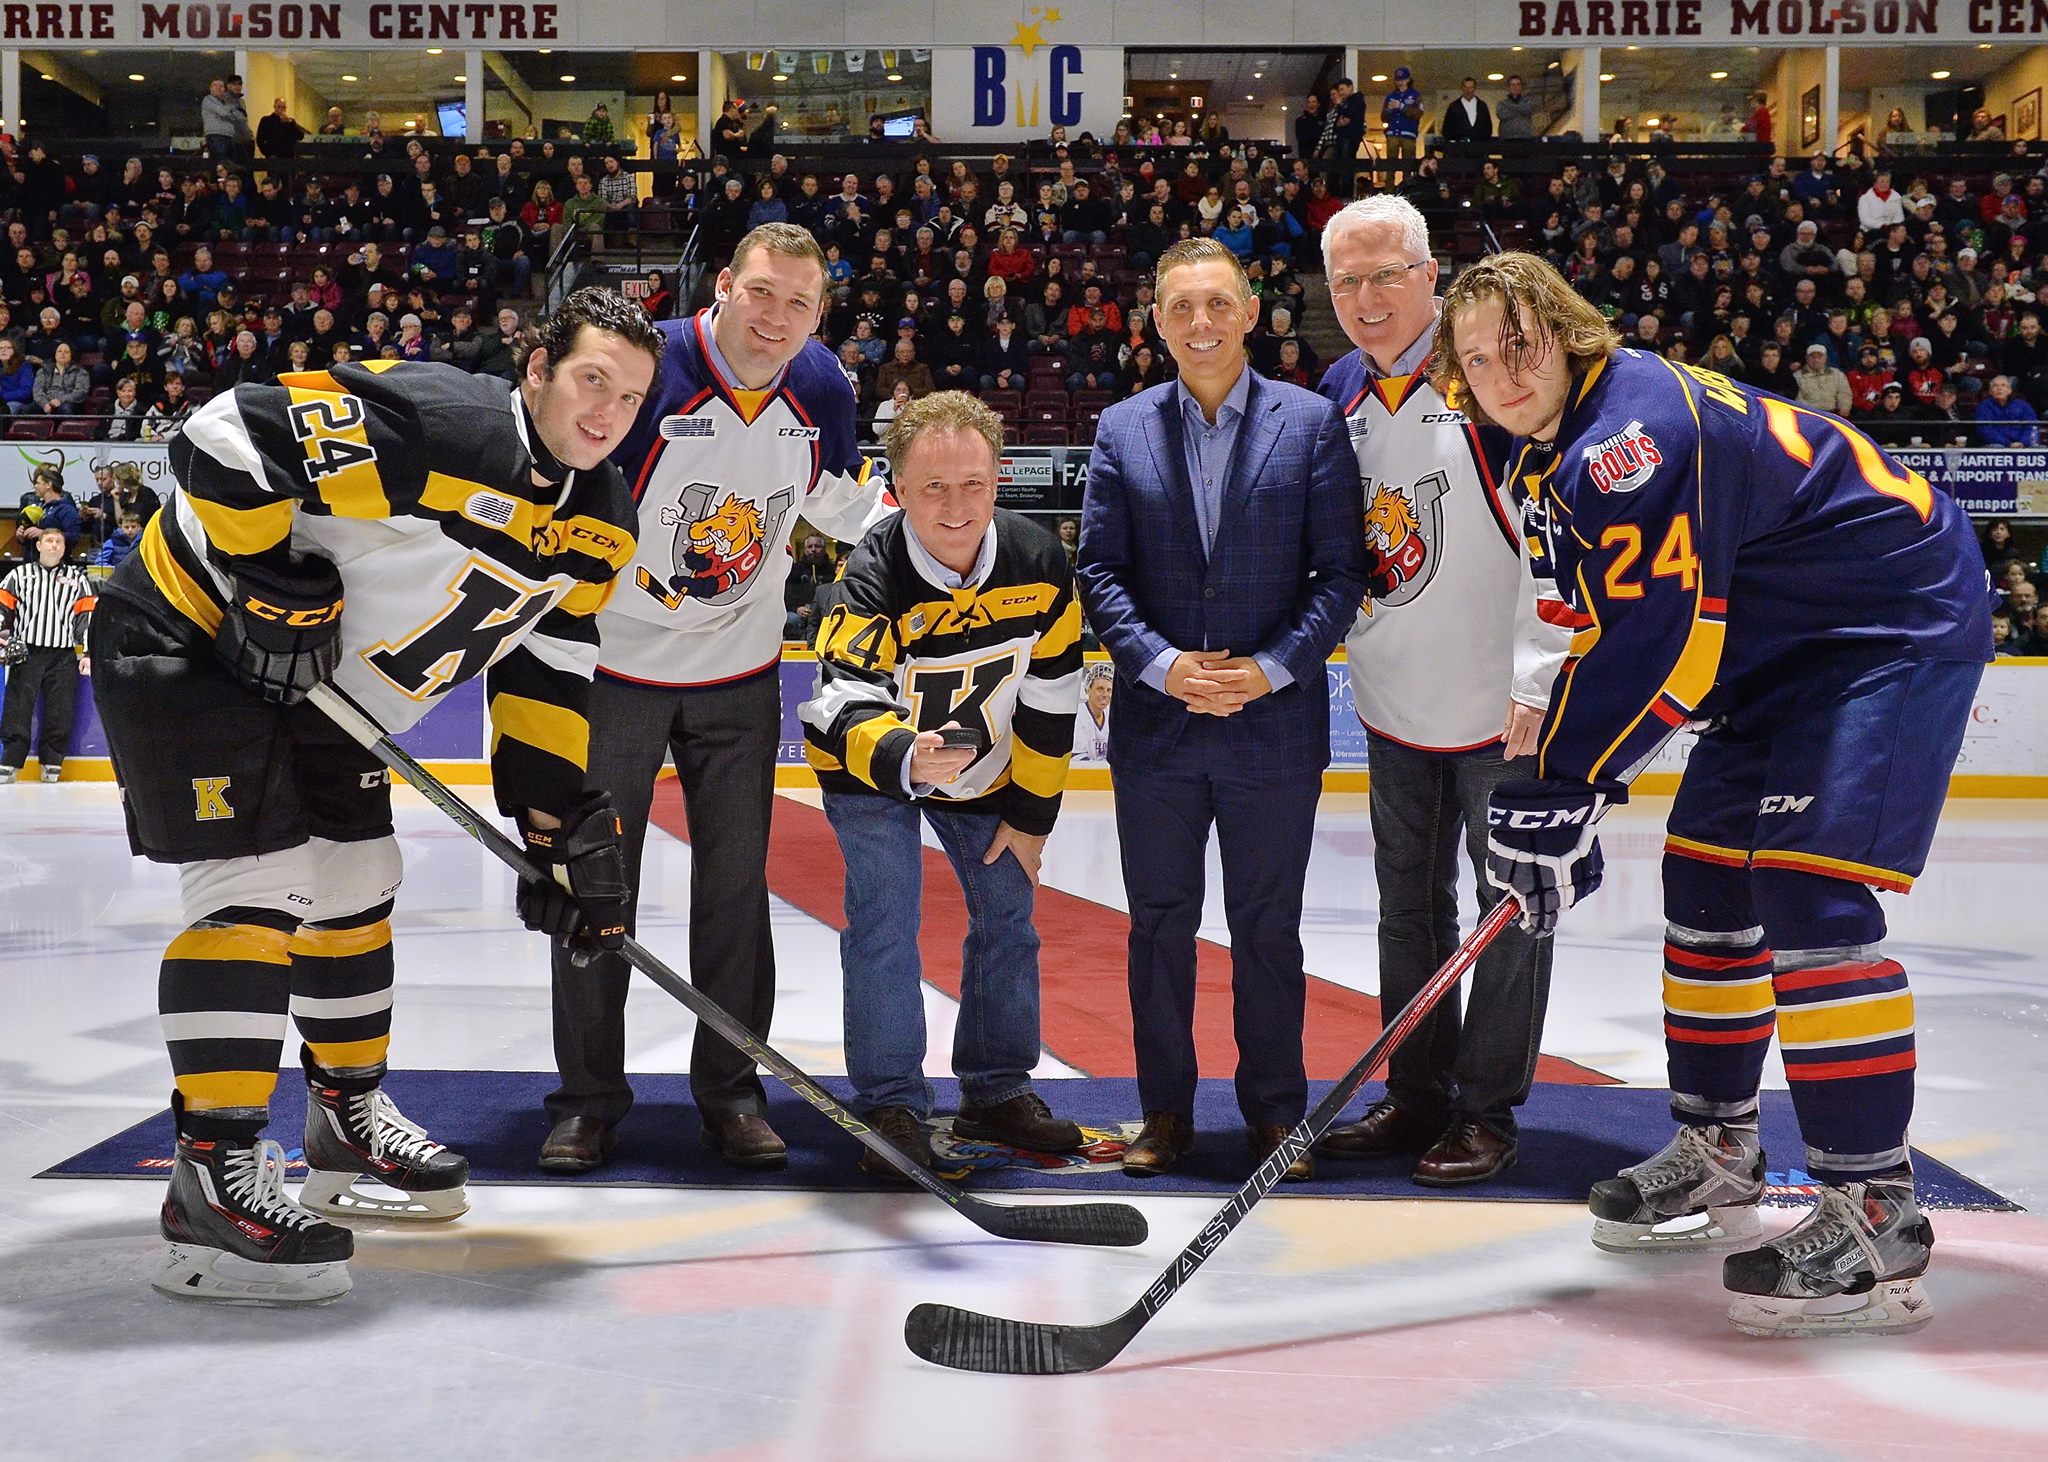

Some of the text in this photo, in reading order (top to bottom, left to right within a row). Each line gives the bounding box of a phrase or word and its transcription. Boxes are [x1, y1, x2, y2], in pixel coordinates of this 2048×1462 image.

[4, 3, 559, 39] RRIE MOLSON CENTRE
[1519, 1, 1702, 35] BARRIE
[1730, 0, 1938, 35] MOLSON
[625, 281, 649, 296] EXIT
[1420, 413, 1465, 424] CCM
[287, 394, 379, 483] 24
[778, 427, 818, 438] CCM
[1589, 434, 1663, 493] COLTS
[1952, 455, 2014, 467] HARTER
[2017, 455, 2046, 467] BUS
[571, 526, 621, 551] CCM
[1600, 512, 1699, 599] 24
[1001, 595, 1039, 605] CCM
[358, 556, 567, 702] K
[905, 646, 1021, 780] K
[192, 776, 234, 821] K
[1759, 795, 1815, 817] CM
[1487, 805, 1590, 829] CCM
[527, 831, 552, 843] CCM
[237, 1219, 262, 1235] CCM
[1141, 1119, 1315, 1318] EASTON
